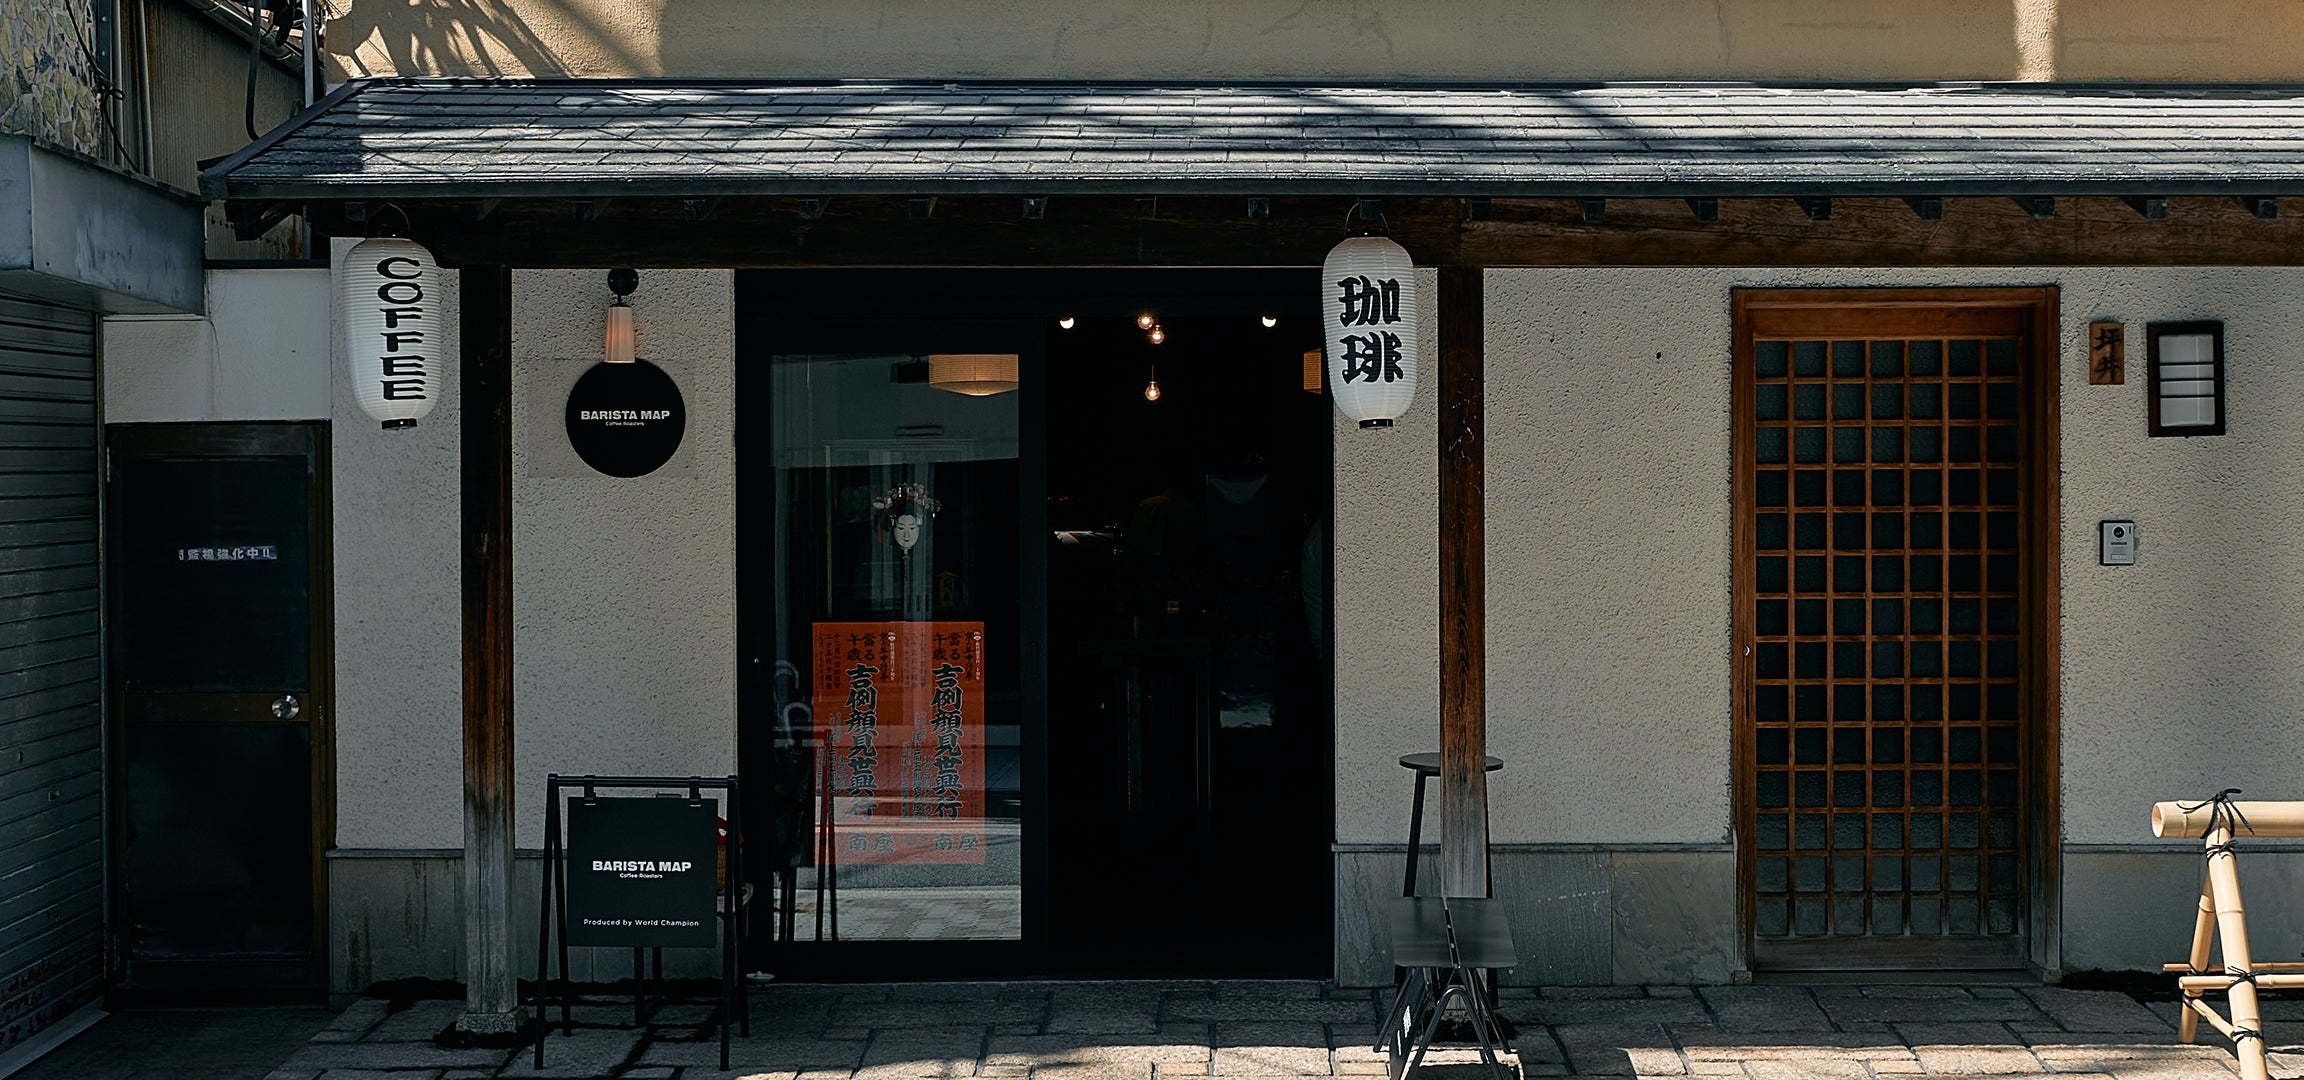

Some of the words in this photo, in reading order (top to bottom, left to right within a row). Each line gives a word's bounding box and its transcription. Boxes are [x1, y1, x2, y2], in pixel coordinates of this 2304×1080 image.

[376, 256, 427, 401] COFFEE
[1337, 275, 1404, 385] 珈琲
[2094, 328, 2122, 384] 坪井
[580, 410, 637, 420] BARISTA
[640, 410, 671, 420] MAP
[844, 662, 879, 822] 吉例顔見世興行
[930, 662, 964, 821] 吉例顔見世興行
[592, 860, 656, 872] BARISTA
[659, 861, 692, 872] MAP
[583, 918, 621, 926] Produced
[622, 919, 632, 928] by
[634, 919, 659, 927] World
[661, 919, 700, 928] Champion
